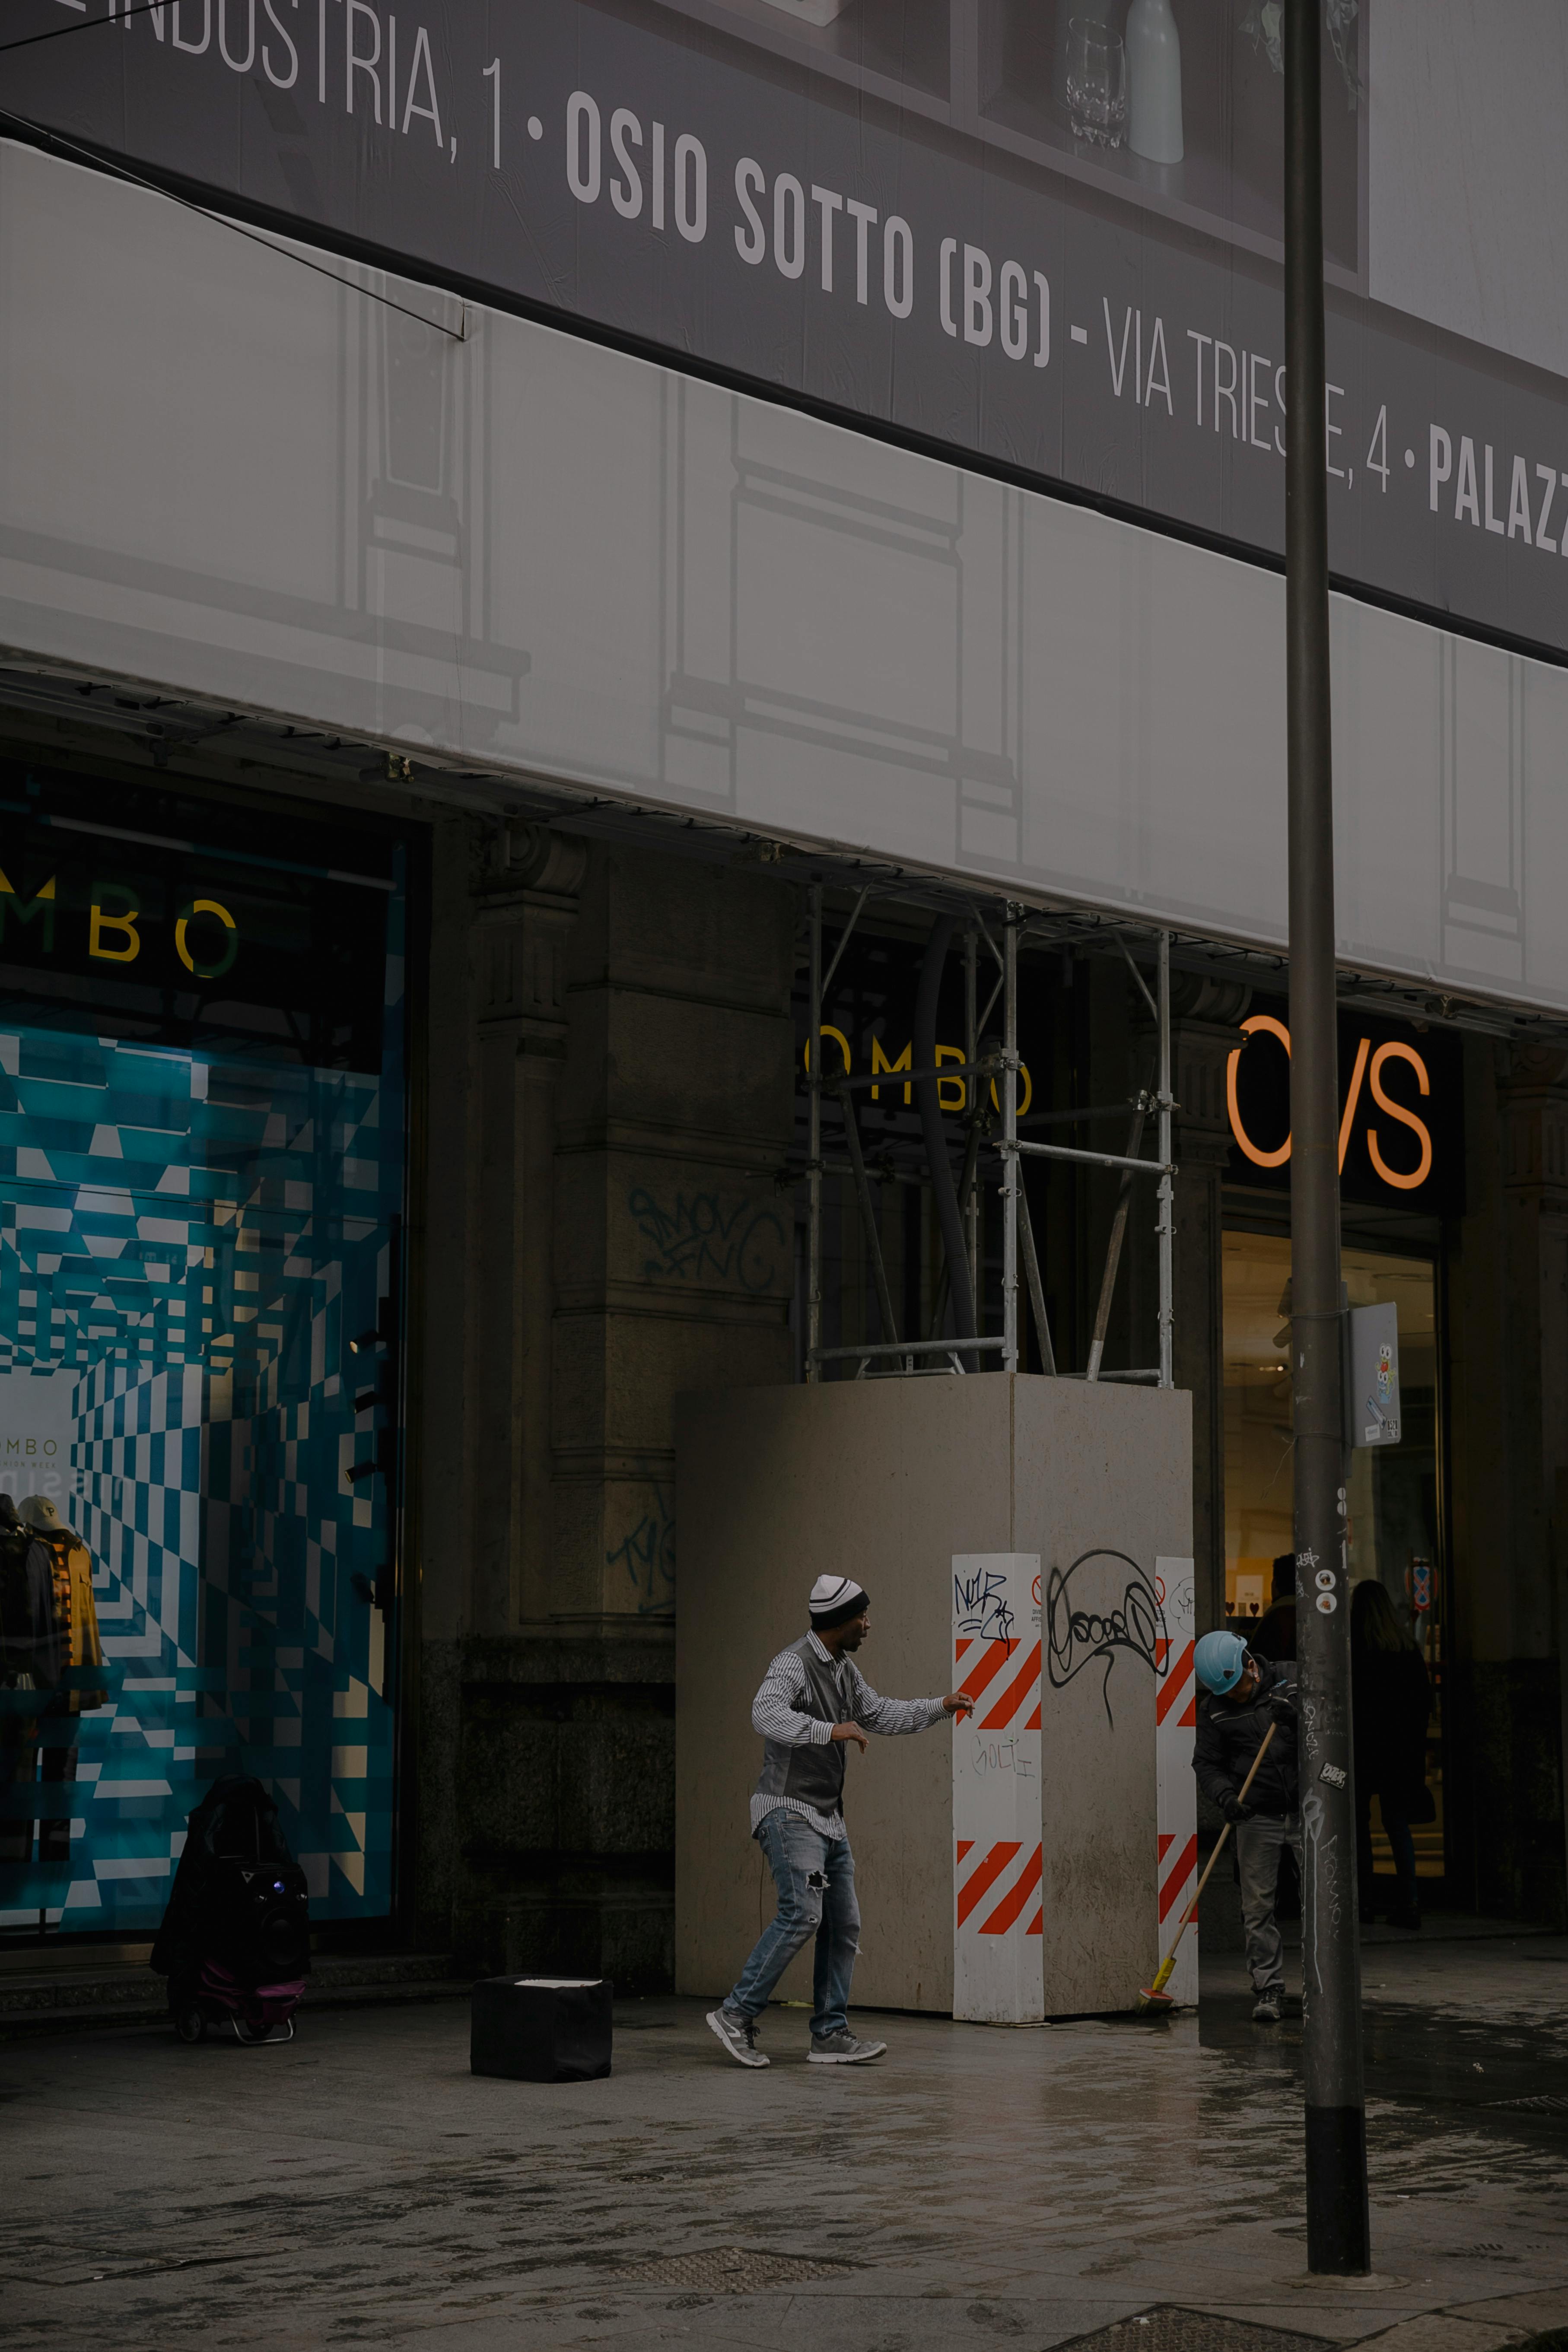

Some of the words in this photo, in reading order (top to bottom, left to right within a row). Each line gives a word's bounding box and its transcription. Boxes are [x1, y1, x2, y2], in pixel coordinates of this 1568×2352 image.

[483, 57, 500, 169] 1
[566, 91, 707, 243] OSIO
[734, 157, 913, 319] SOTTO
[940, 237, 1050, 368] (BG)
[1103, 296, 1173, 416] VIA
[1187, 329, 1353, 489] TRIESE,
[1366, 404, 1390, 493] 4
[0, 1438, 57, 1456] MBO
